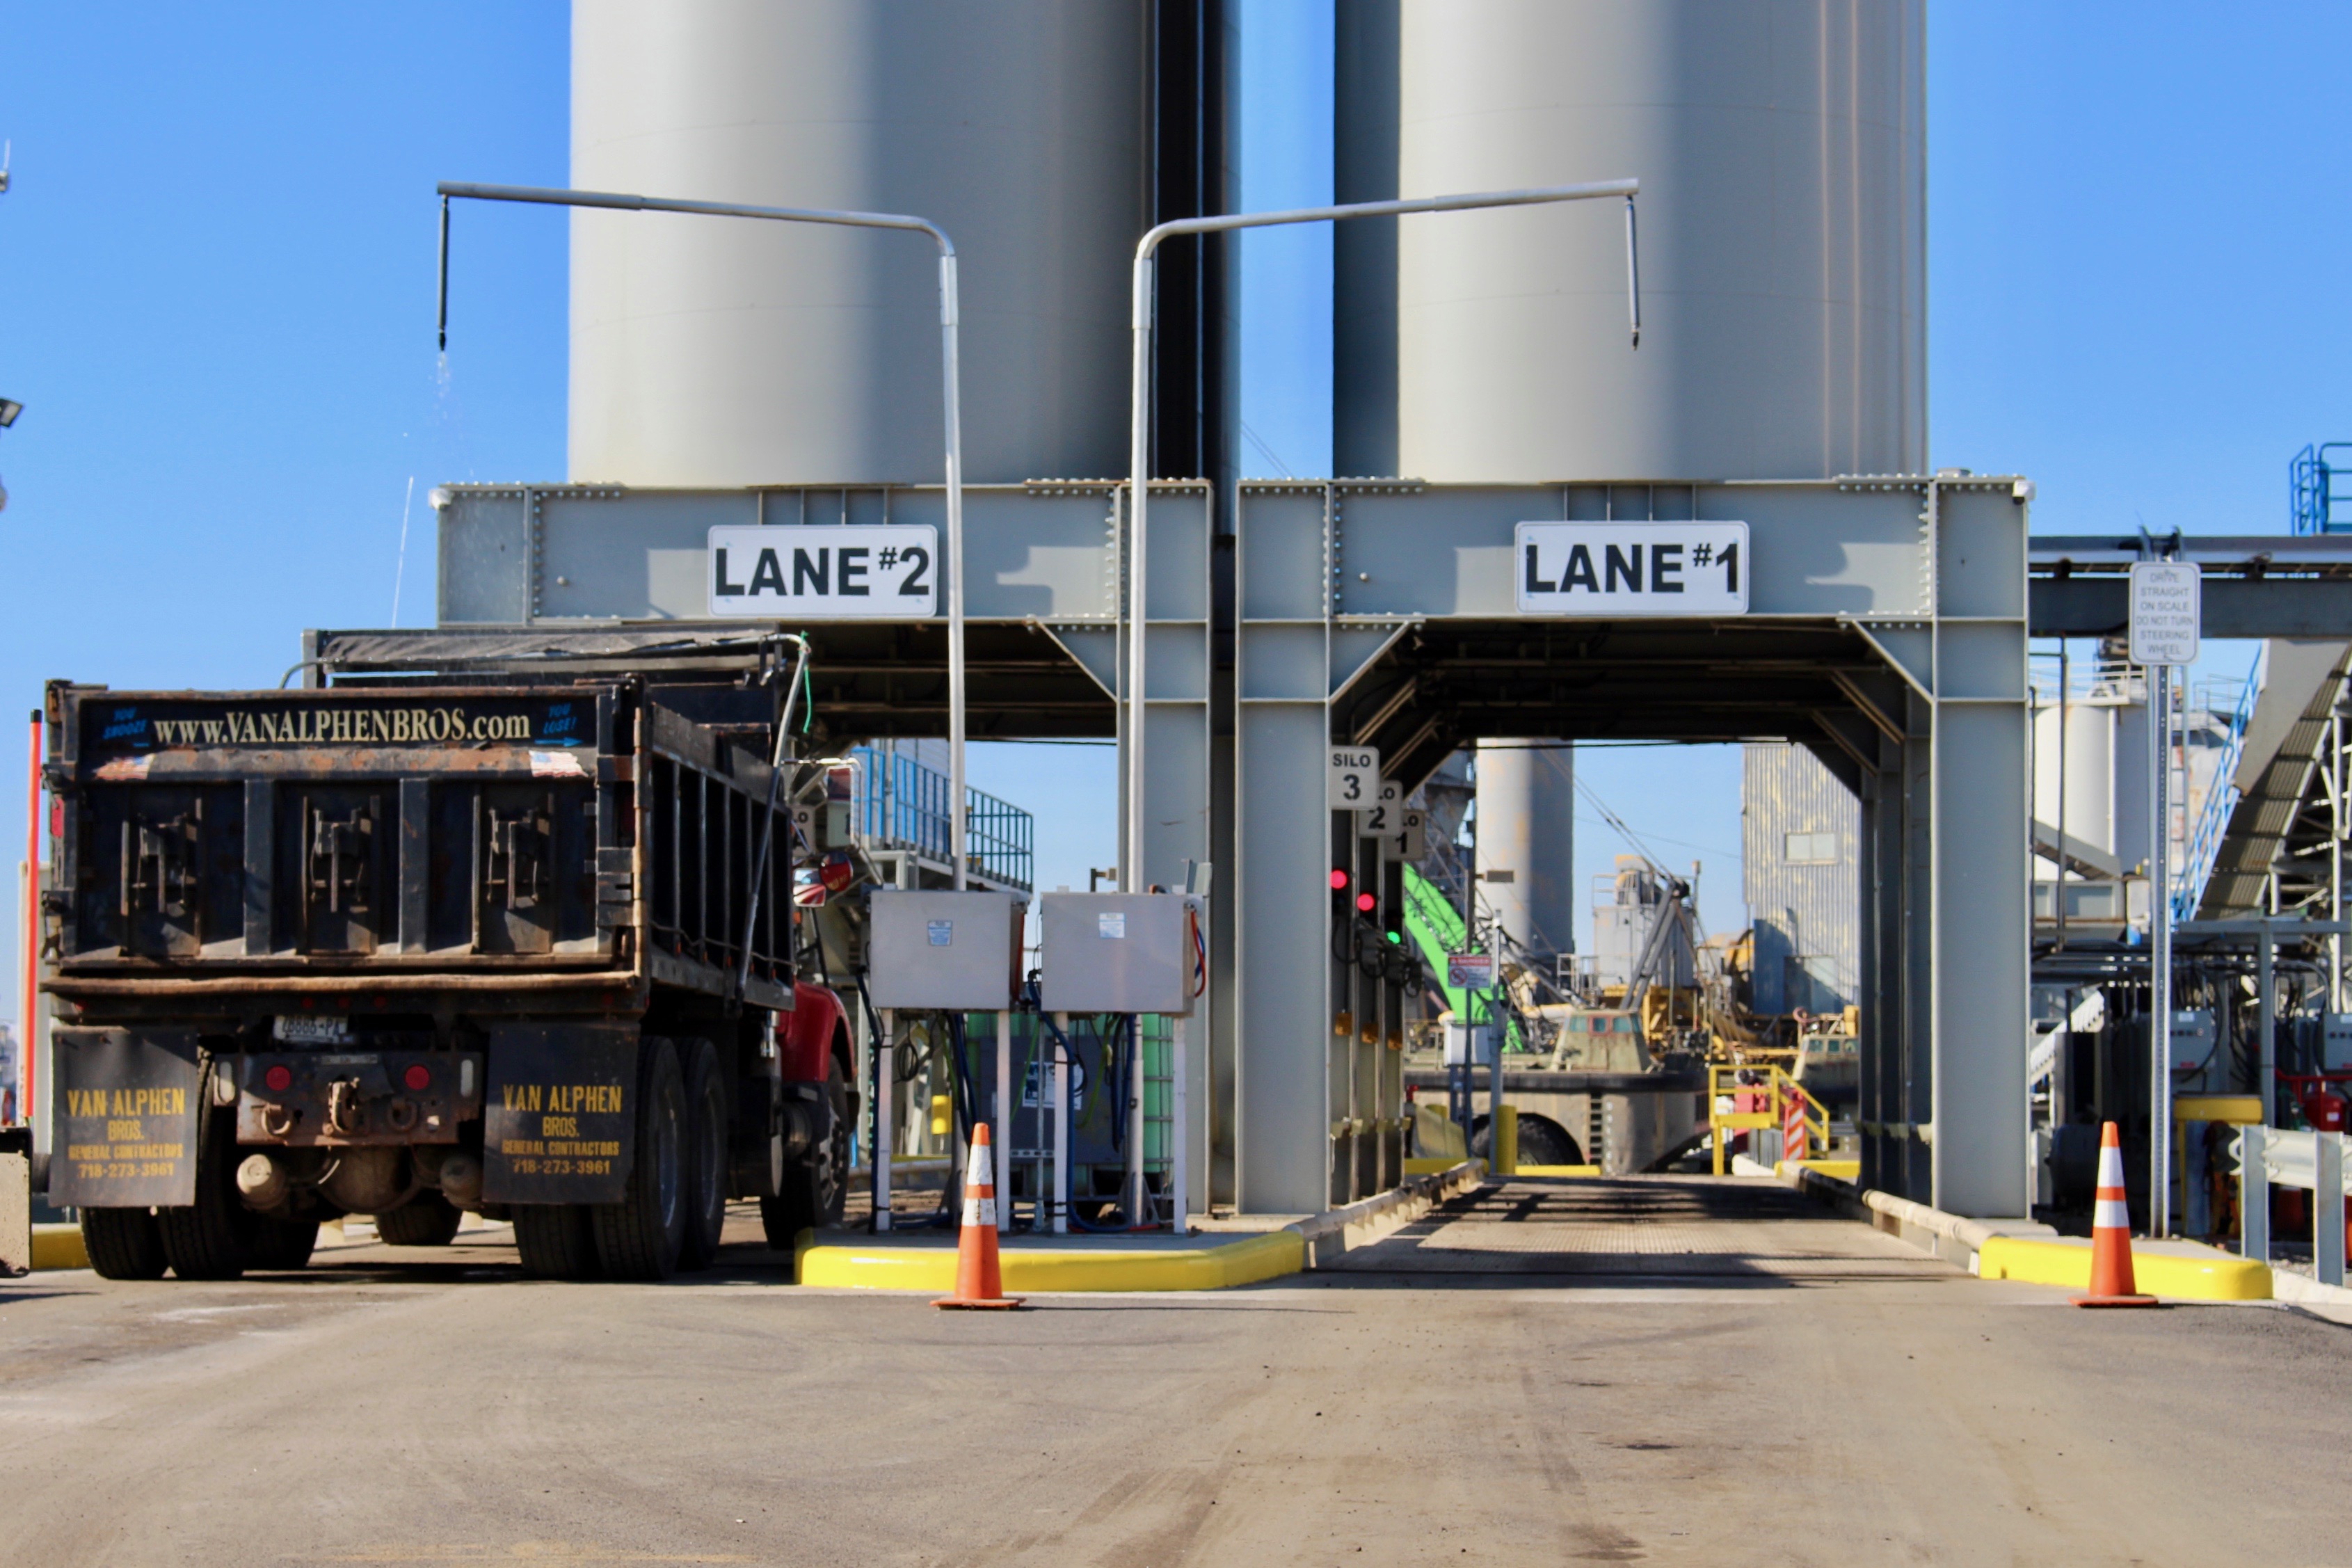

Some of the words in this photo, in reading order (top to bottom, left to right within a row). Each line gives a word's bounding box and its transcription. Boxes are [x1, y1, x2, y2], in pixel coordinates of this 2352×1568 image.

[716, 547, 870, 595] LANE
[879, 547, 929, 595] #2
[1526, 544, 1684, 593] LANE
[1693, 543, 1738, 593] #1
[2141, 586, 2189, 597] STRAIGHT
[2140, 602, 2154, 611] ON
[2158, 602, 2188, 611] SCALE
[2136, 616, 2149, 625] DO
[2152, 616, 2168, 625] NOT
[2171, 616, 2193, 625] TURN
[2141, 630, 2189, 640] STEERING
[2147, 644, 2182, 655] WHEEL
[153, 707, 531, 744] www.VANALPHENBROS.com
[1333, 753, 1371, 767] SILO
[1343, 774, 1361, 800] 3
[1368, 806, 1386, 829] 2
[1395, 832, 1407, 854] 1
[67, 1089, 106, 1118] VAN
[113, 1087, 185, 1117] ALPHEN
[503, 1085, 541, 1112] VAN
[548, 1085, 622, 1113] ALPHEN
[108, 1119, 145, 1142] BROS.
[543, 1116, 579, 1138] BROS.
[69, 1144, 111, 1161] GENERAL
[113, 1142, 183, 1160] CONTRACTORS
[502, 1139, 545, 1155] GENERAL
[548, 1140, 620, 1156] CONTRACTORS
[78, 1162, 174, 1179] 718-273-3961
[513, 1158, 611, 1175] 718-273-3961
